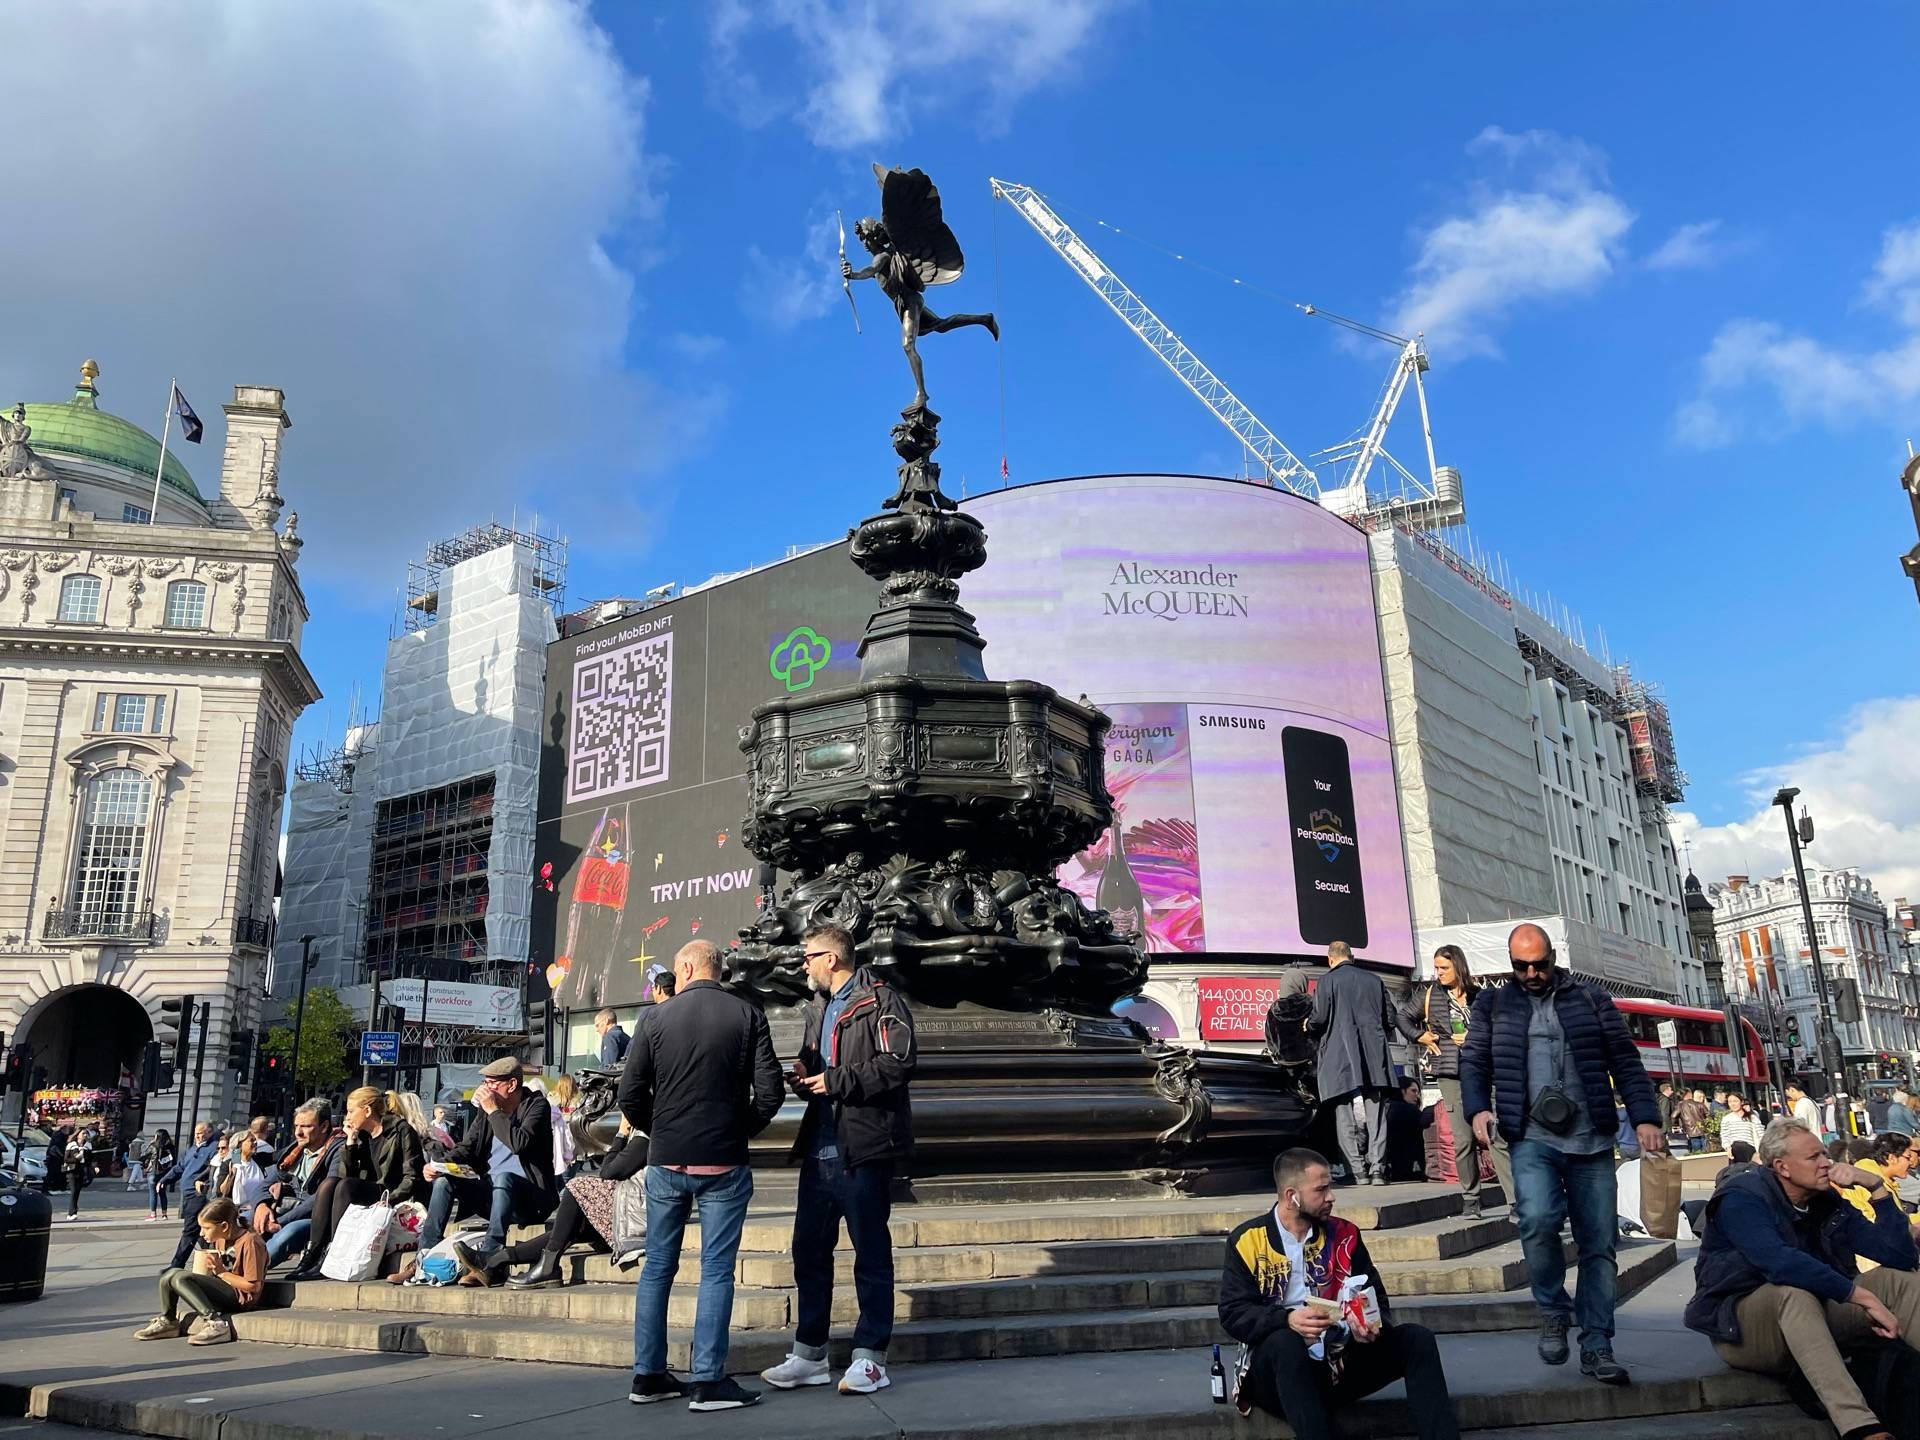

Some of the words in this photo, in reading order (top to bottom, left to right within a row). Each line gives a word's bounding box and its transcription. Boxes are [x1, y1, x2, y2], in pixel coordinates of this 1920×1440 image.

[1110, 562, 1238, 588] Alexander
[1102, 591, 1248, 621] McQUEEN
[576, 640, 595, 656] Find
[596, 635, 616, 651] your
[618, 622, 651, 642] MobED
[653, 615, 673, 631] NFT
[1199, 715, 1266, 730] SAMSUNG
[1104, 724, 1175, 746] érignon
[1113, 749, 1153, 764] GAGA
[1314, 779, 1331, 792] Your
[1297, 828, 1335, 842] Personal
[1335, 833, 1354, 846] Data.
[650, 881, 685, 903] TRY
[687, 878, 703, 897] IT
[706, 868, 753, 894] NOW
[1315, 880, 1351, 894] Secured.
[415, 994, 433, 1004] thir
[434, 996, 473, 1006] workforce
[1201, 989, 1252, 1003] 144,000
[1255, 989, 1274, 1002] SQ
[1216, 1003, 1229, 1016] of
[1210, 1017, 1253, 1030] RETAIL
